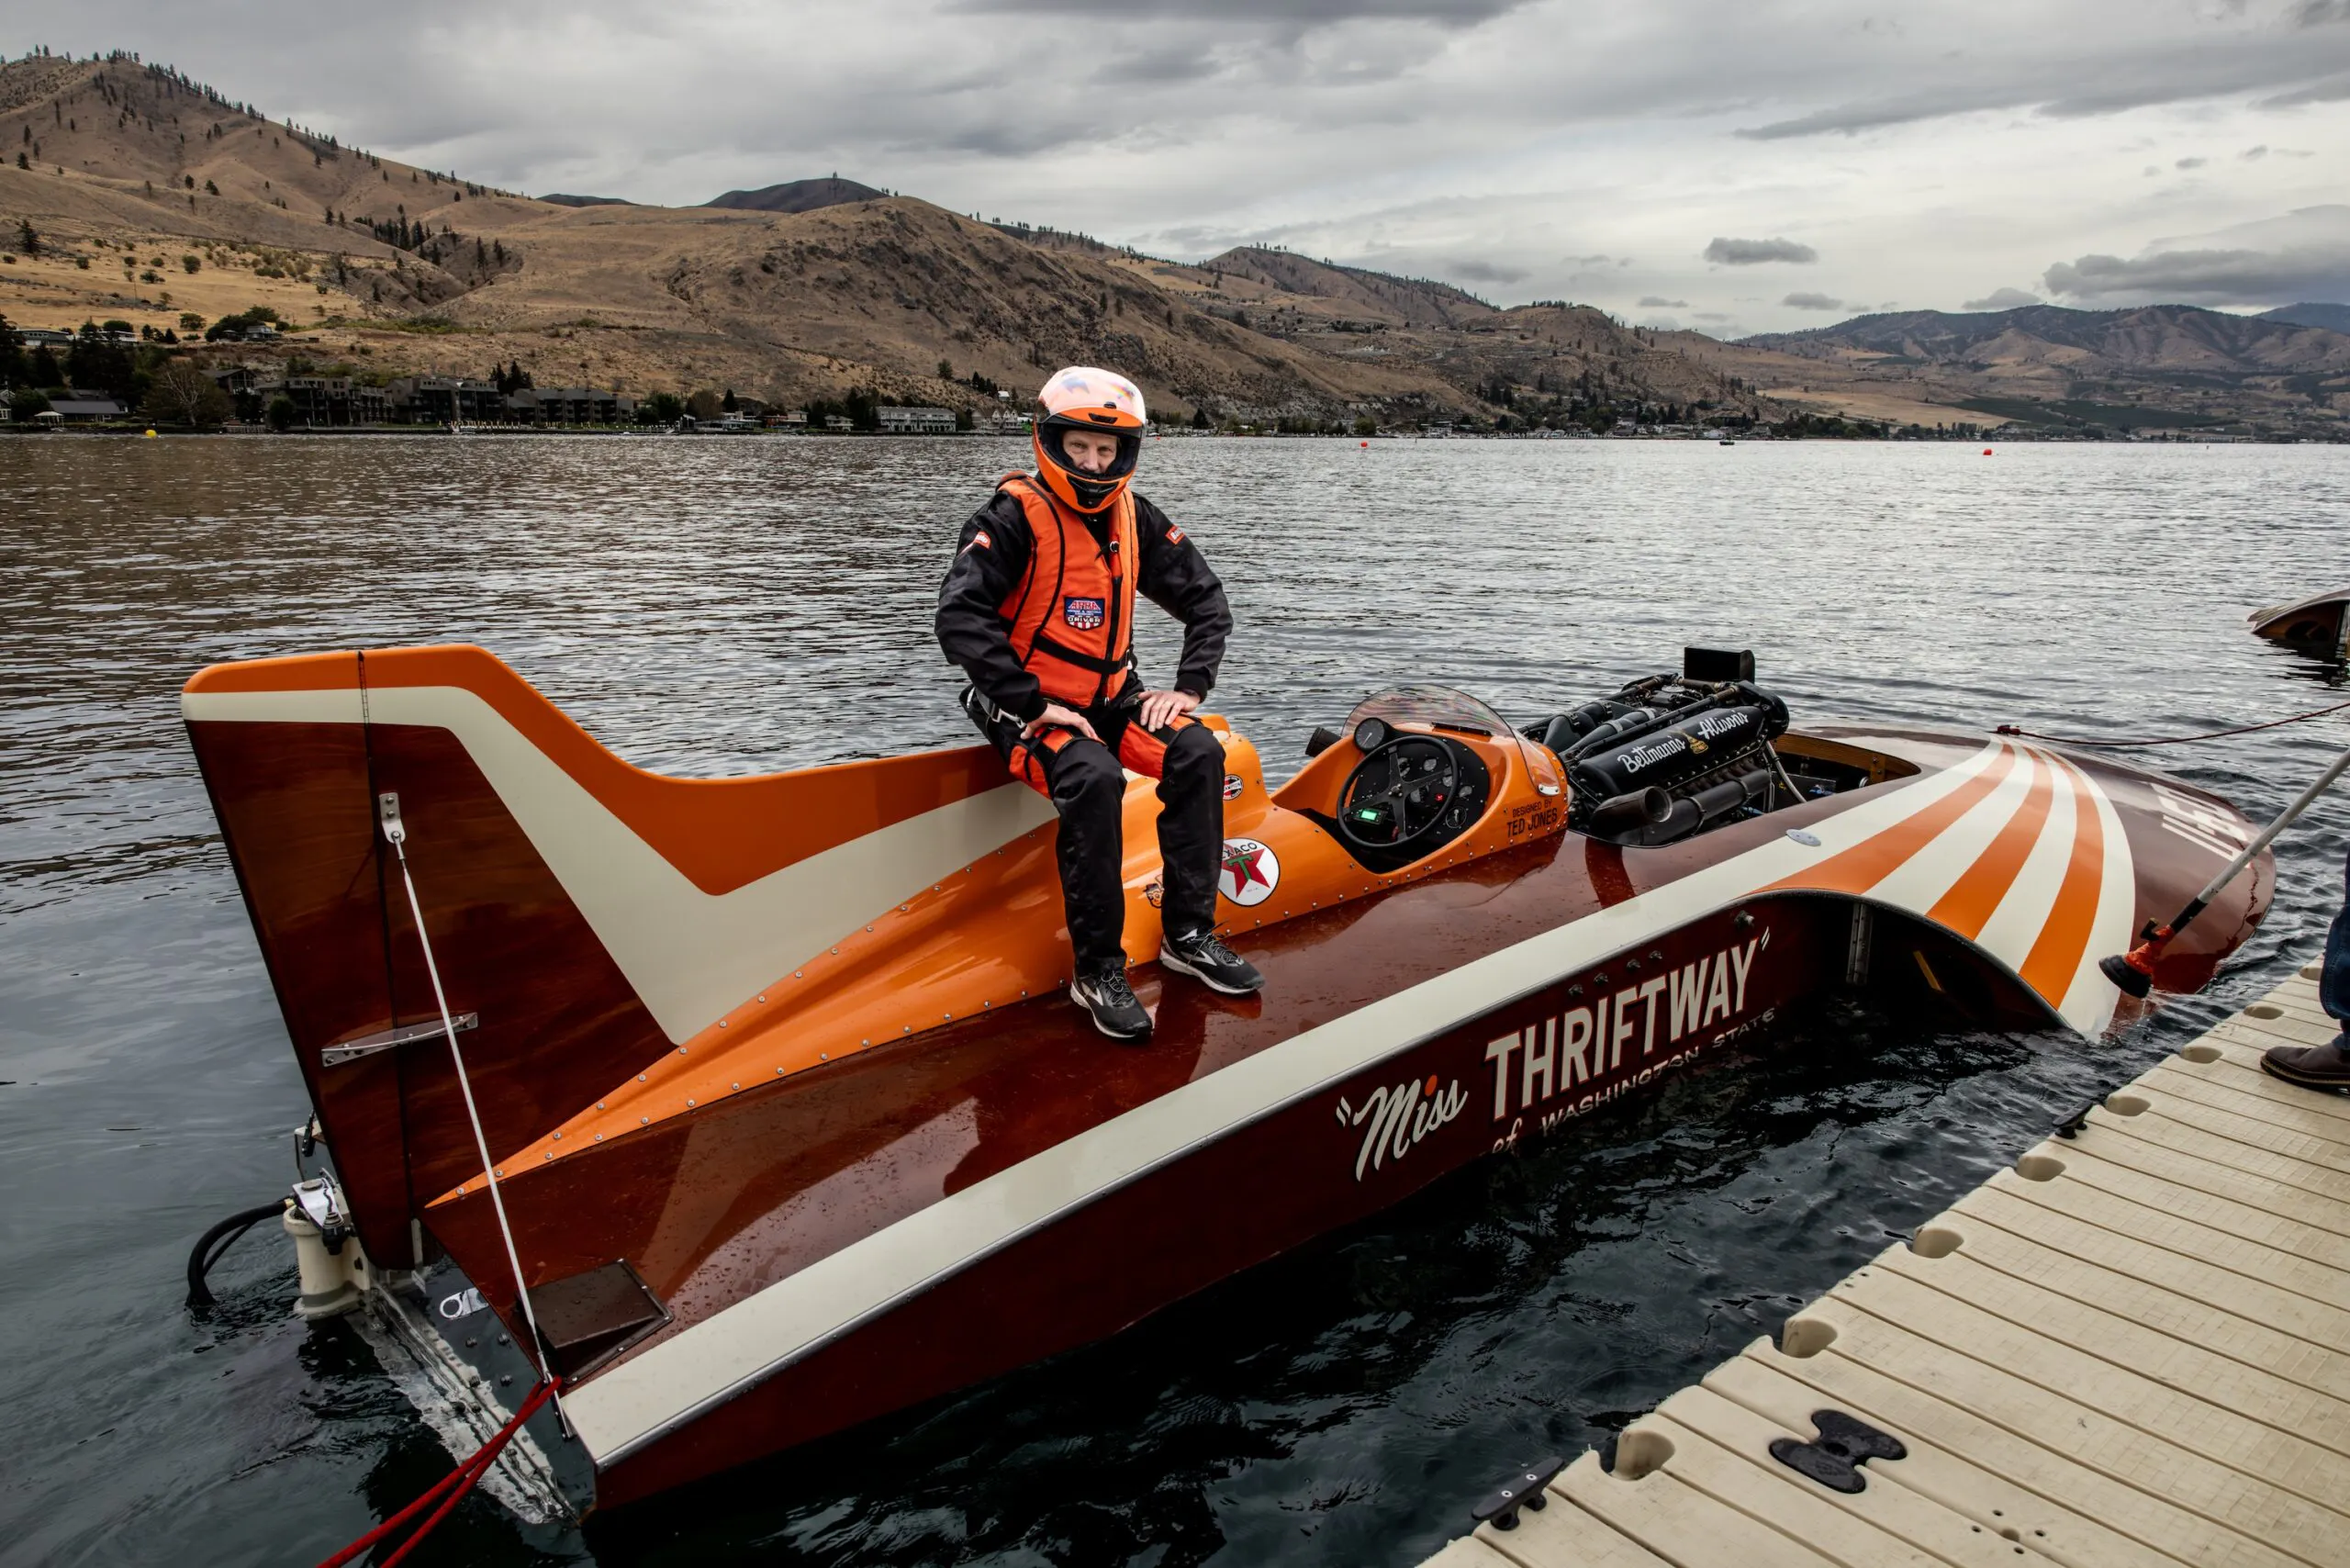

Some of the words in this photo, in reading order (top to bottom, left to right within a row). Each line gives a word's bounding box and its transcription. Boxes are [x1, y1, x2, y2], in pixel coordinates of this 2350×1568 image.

[1617, 735, 1685, 773] Bettmann's
[1697, 710, 1749, 740] Allison's
[1506, 818, 1526, 837] TED
[1528, 808, 1558, 830] JONES
[1513, 801, 1541, 817] DESIGNED
[1544, 799, 1552, 809] BY
[1492, 1117, 1523, 1155] of
